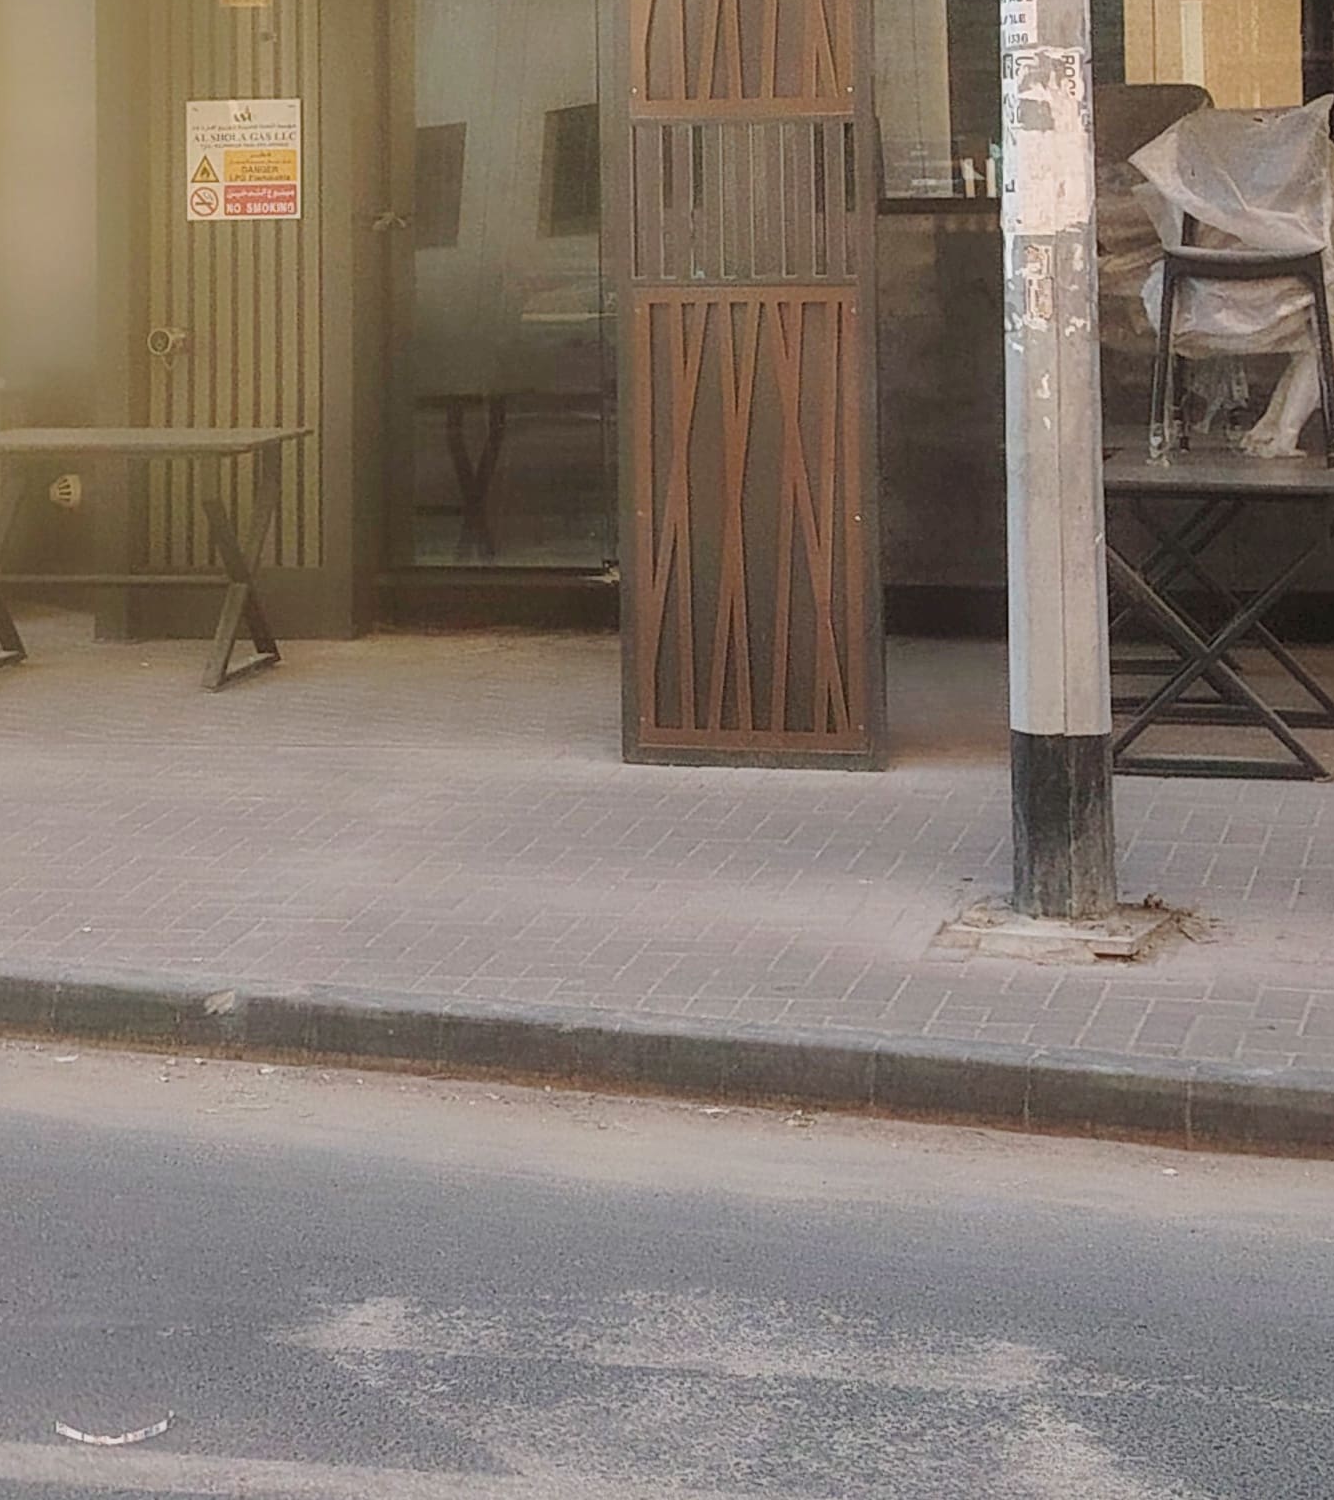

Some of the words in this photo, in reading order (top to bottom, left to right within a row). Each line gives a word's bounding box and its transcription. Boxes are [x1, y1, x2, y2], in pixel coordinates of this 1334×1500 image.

[250, 131, 272, 141] GAS
[225, 202, 242, 214] NO
[246, 202, 296, 214] SMOKING
